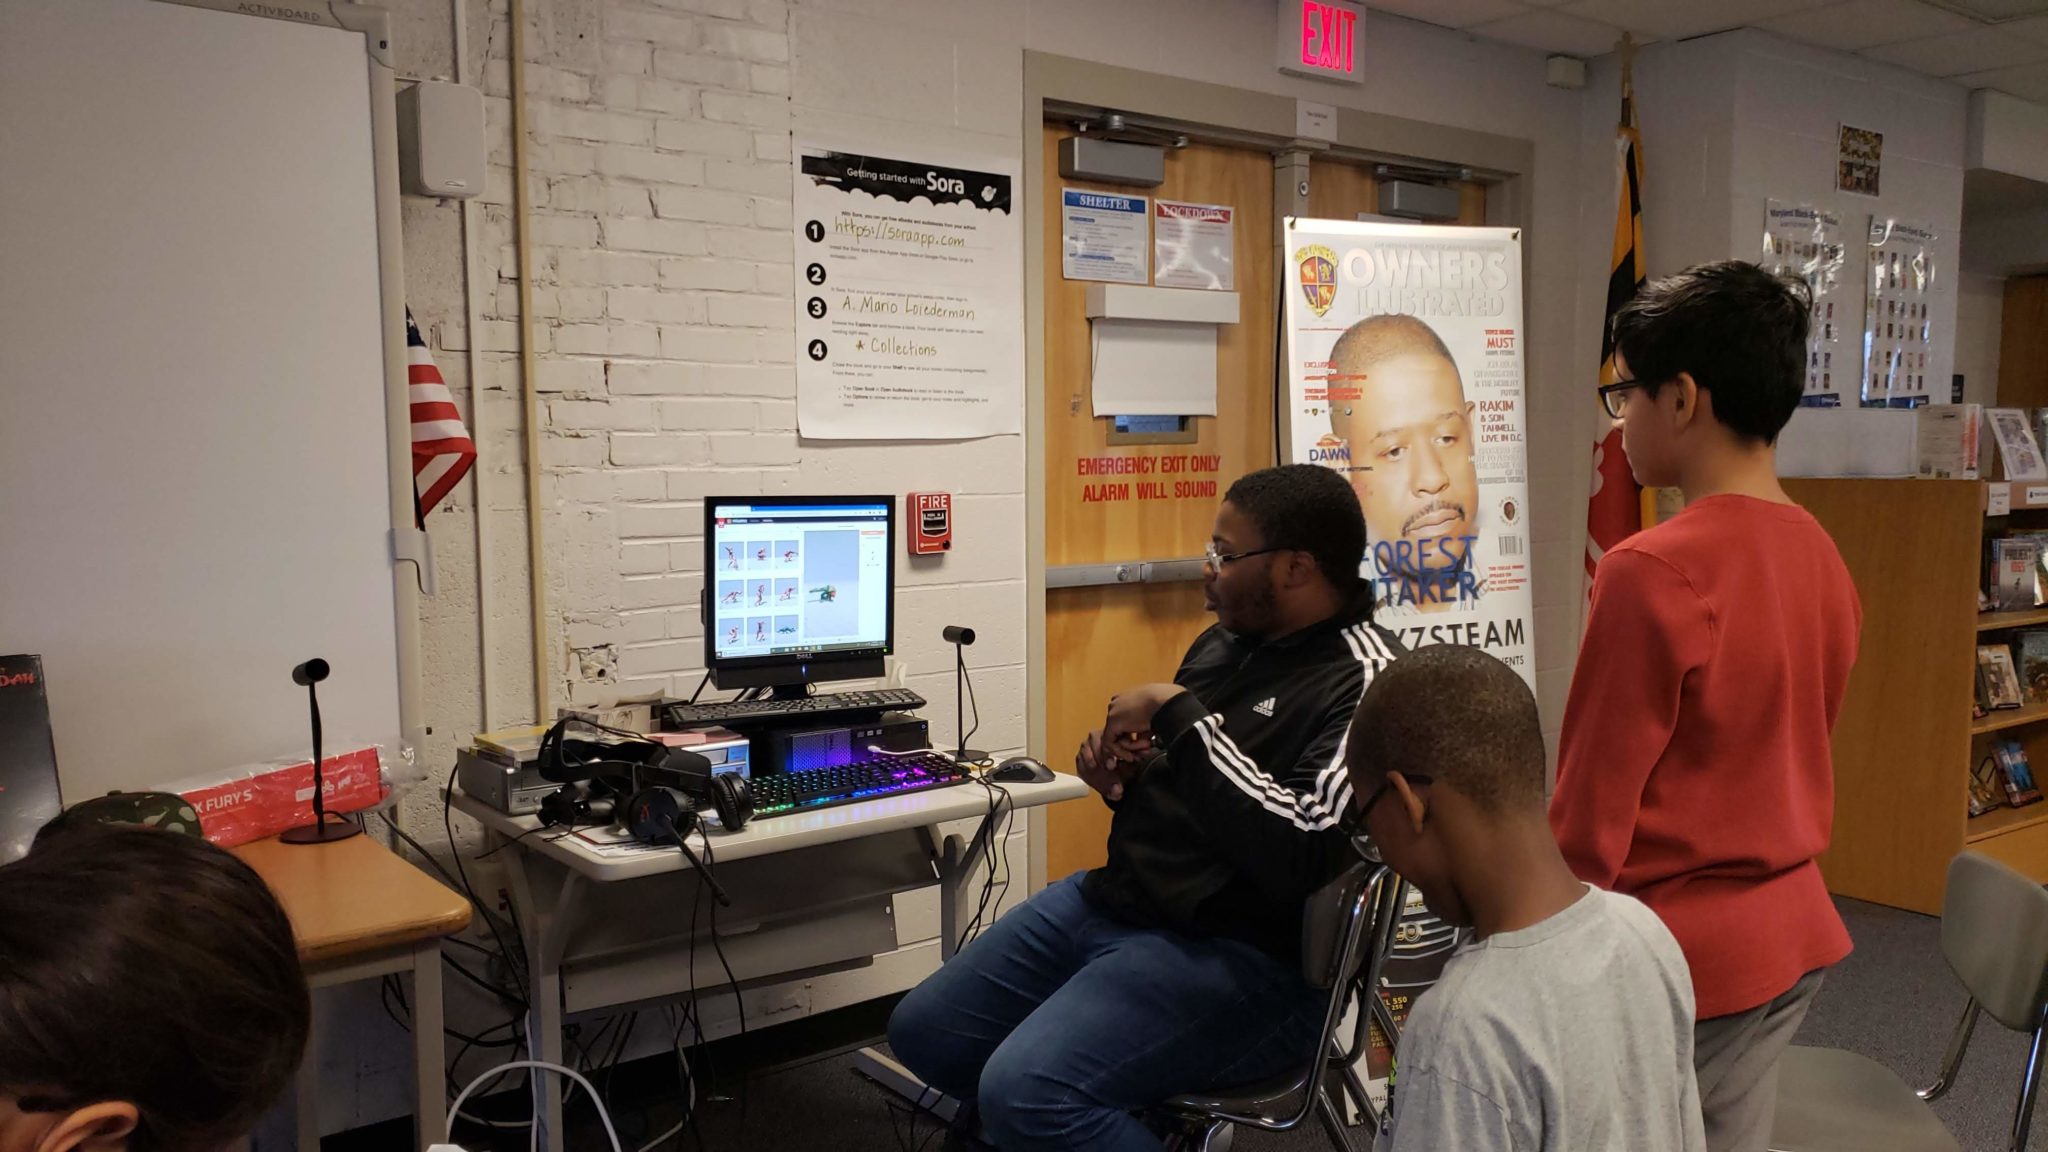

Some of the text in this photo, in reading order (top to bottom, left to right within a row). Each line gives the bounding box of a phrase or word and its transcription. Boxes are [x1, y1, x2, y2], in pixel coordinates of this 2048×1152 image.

[1302, 0, 1357, 73] EXIT
[847, 167, 965, 195] Getting started with Sora
[1079, 194, 1131, 211] SHELTER
[1163, 204, 1224, 220] LOCKDOWN
[834, 215, 965, 248] https://soraapp.com
[1343, 248, 1508, 291] OWNERS
[842, 296, 976, 320] A. Mario Loiederman
[1357, 288, 1505, 317] ILLUSTRATED
[871, 337, 937, 357] Collections
[1486, 337, 1516, 348] MUST
[1480, 400, 1514, 412] RAKIM
[1481, 434, 1499, 443] LIVE
[1501, 434, 1509, 442] IN
[1309, 448, 1350, 461] DAWN
[1078, 455, 1221, 475] EMERGENCY EXIT ONLY
[1083, 481, 1217, 502] ALARM WILL SOUND
[920, 496, 948, 509] FIRE
[1362, 536, 1478, 577] OREST
[1252, 705, 1274, 717] adidas
[206, 792, 240, 812] FURY
[243, 788, 253, 802] S
[1392, 996, 1408, 1005] 550
